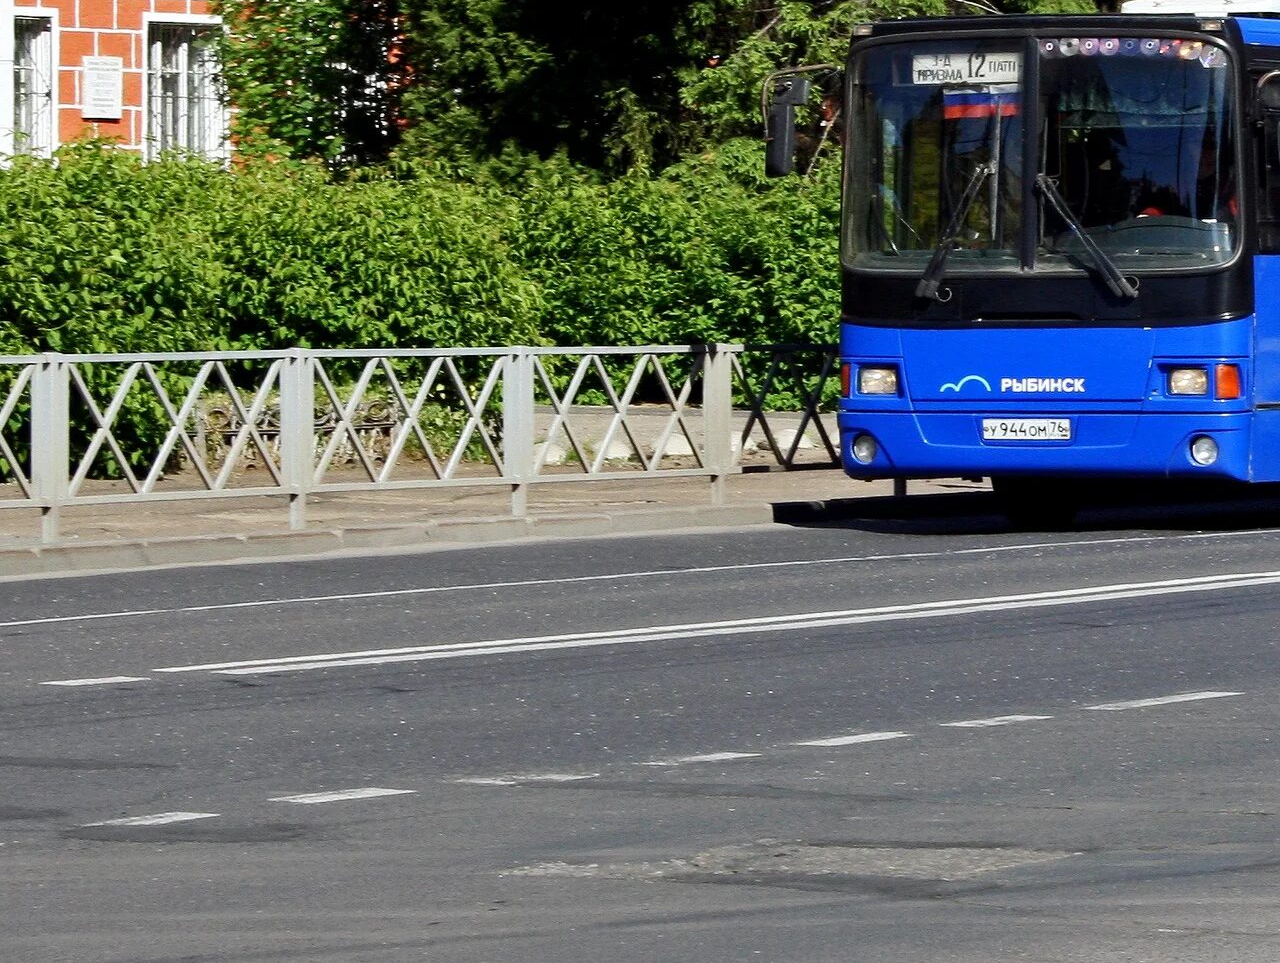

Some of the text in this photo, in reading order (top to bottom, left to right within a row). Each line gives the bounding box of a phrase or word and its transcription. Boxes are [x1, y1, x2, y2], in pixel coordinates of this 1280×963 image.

[967, 53, 986, 77] 12
[988, 60, 1016, 72] ПАТП
[1001, 378, 1085, 392] РЫБИНСК
